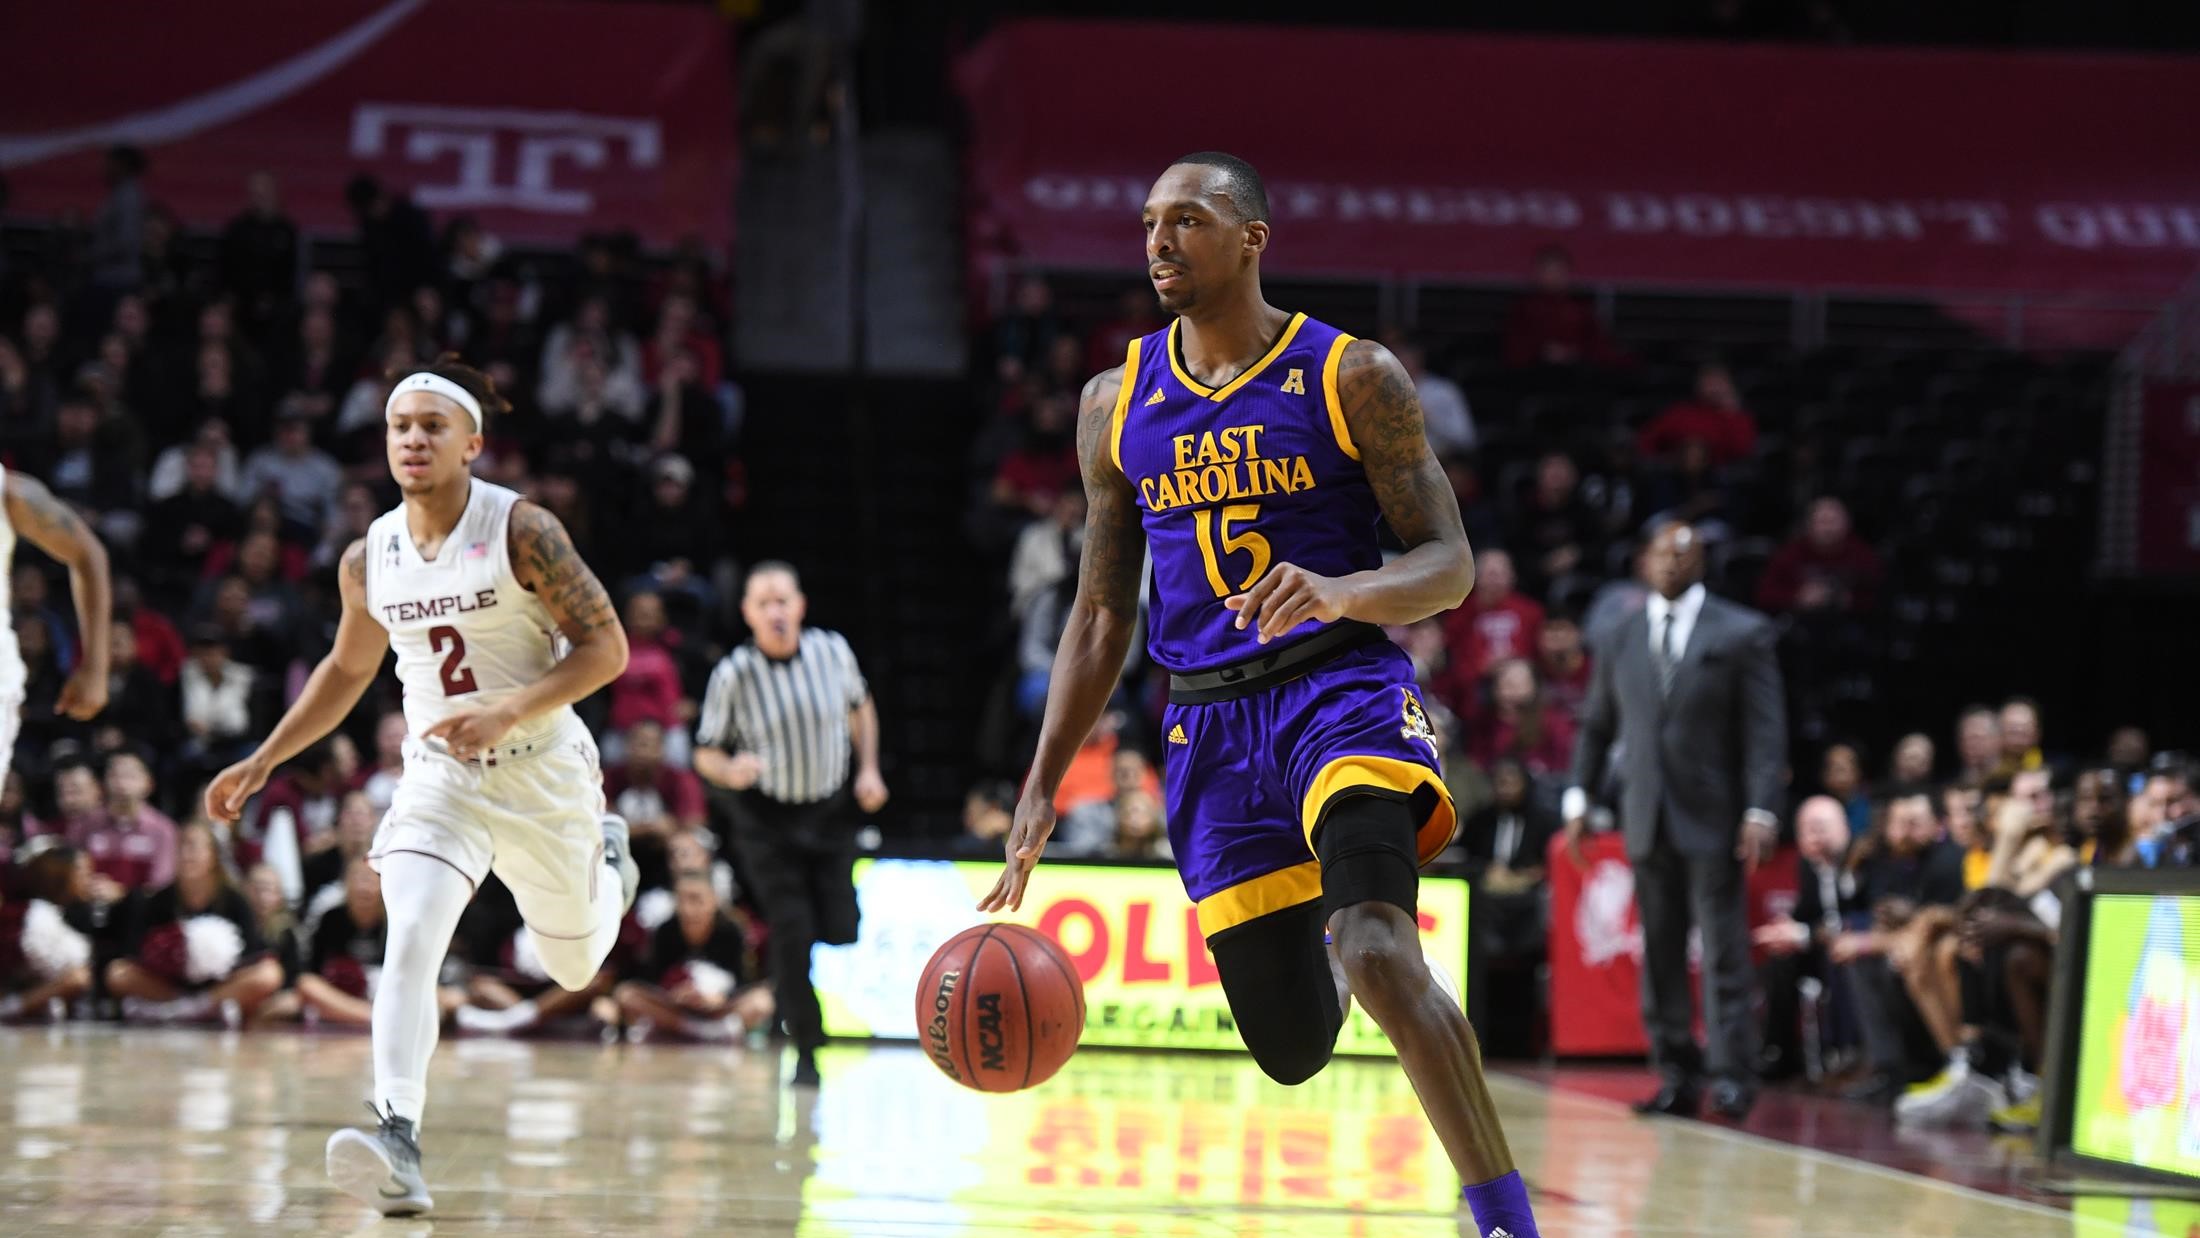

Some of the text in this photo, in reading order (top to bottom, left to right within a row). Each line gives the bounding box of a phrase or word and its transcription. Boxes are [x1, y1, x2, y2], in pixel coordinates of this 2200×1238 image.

[1173, 424, 1264, 472] EAST
[1141, 455, 1317, 513] CAROLINA
[1192, 503, 1272, 598] 15
[382, 588, 498, 624] TEMPLE
[428, 625, 479, 697] 2
[976, 993, 1006, 1072] NCAA
